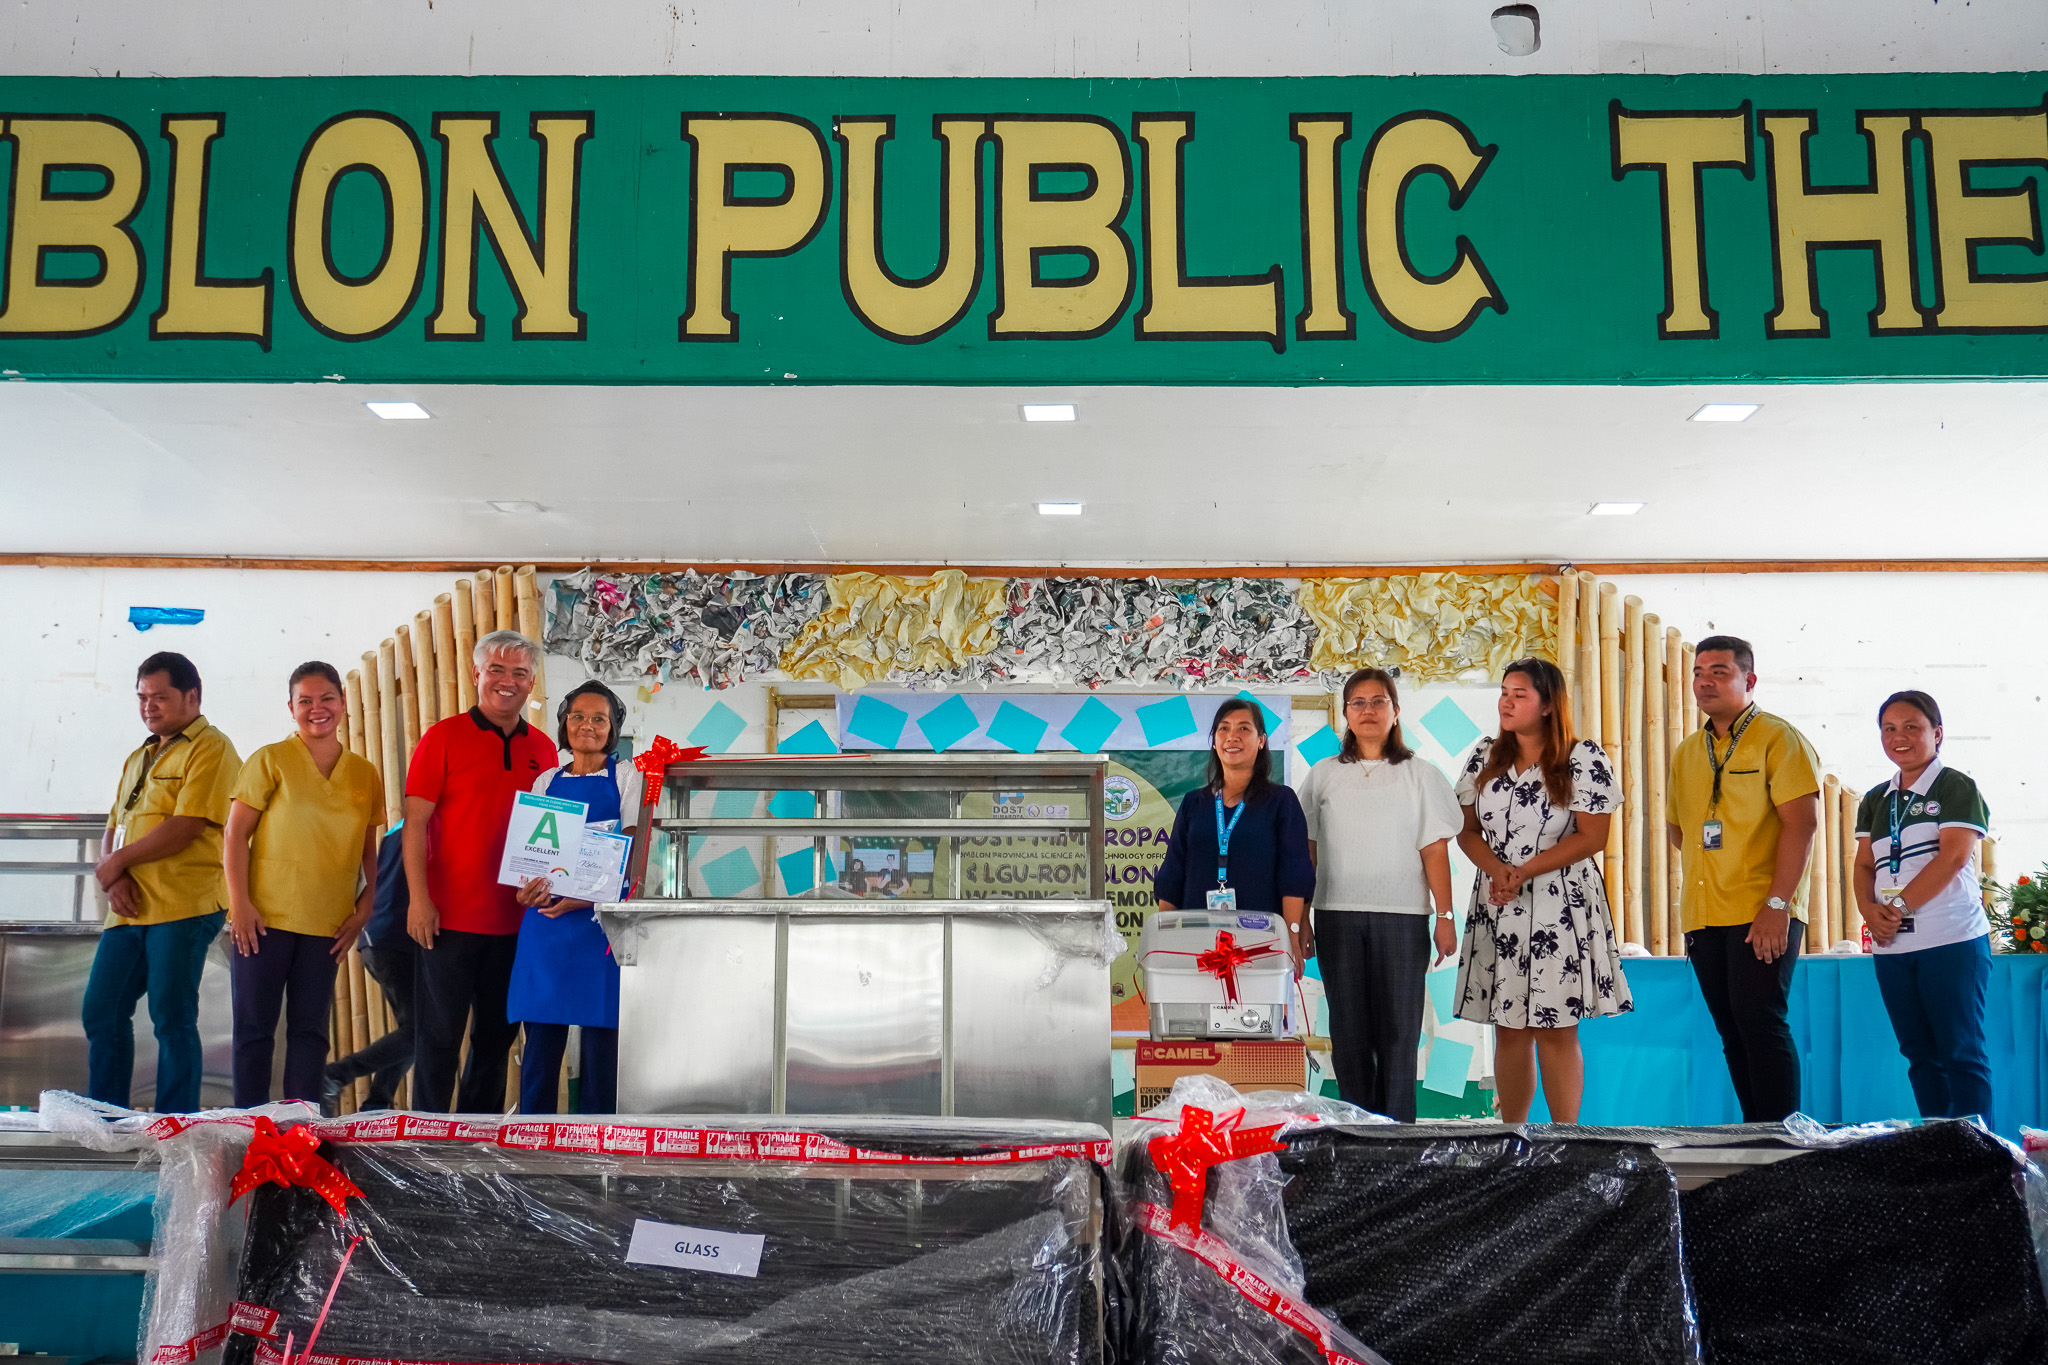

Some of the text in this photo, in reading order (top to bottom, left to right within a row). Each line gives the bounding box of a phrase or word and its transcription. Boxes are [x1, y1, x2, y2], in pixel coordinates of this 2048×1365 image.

[0, 98, 2048, 354] BLON PUBLIC THE
[993, 805, 1024, 814] DOST
[527, 811, 560, 849] A
[524, 845, 560, 857] EXCELLENT
[1154, 1047, 1216, 1060] CAMEL
[419, 1119, 451, 1128] FRAGILE
[520, 1124, 550, 1133] FRAGILE
[568, 1126, 599, 1135] FRAGILE
[616, 1128, 647, 1138] FRAGILE
[668, 1130, 700, 1140] FRAGILE
[720, 1133, 751, 1142] FRAGILE
[771, 1134, 800, 1144] FRAGILE
[674, 1241, 720, 1258] GLASS
[1246, 1273, 1275, 1297] FRAGILE
[240, 1304, 272, 1319] FRAGILE
[309, 1355, 340, 1365] FRAGILE
